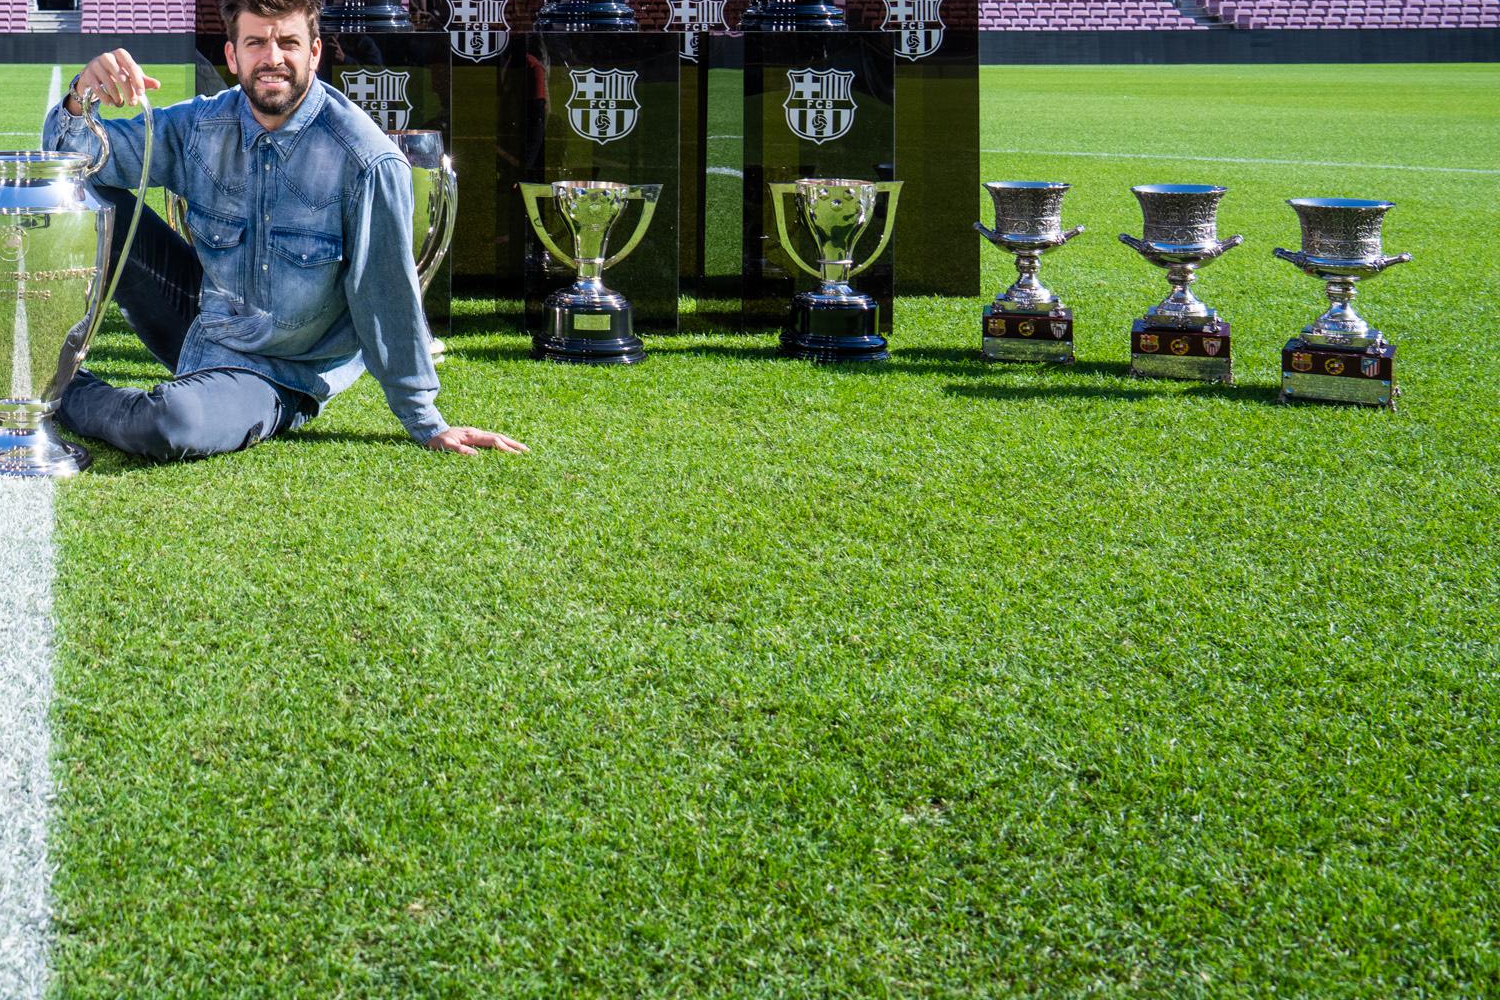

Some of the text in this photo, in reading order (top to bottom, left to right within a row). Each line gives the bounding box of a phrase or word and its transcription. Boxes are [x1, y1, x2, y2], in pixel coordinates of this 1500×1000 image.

[465, 23, 489, 31] FCB
[685, 23, 708, 32] FCB
[901, 22, 925, 30] FCB
[361, 101, 388, 110] FCB
[589, 100, 616, 109] FCB
[807, 100, 833, 109] FCB
